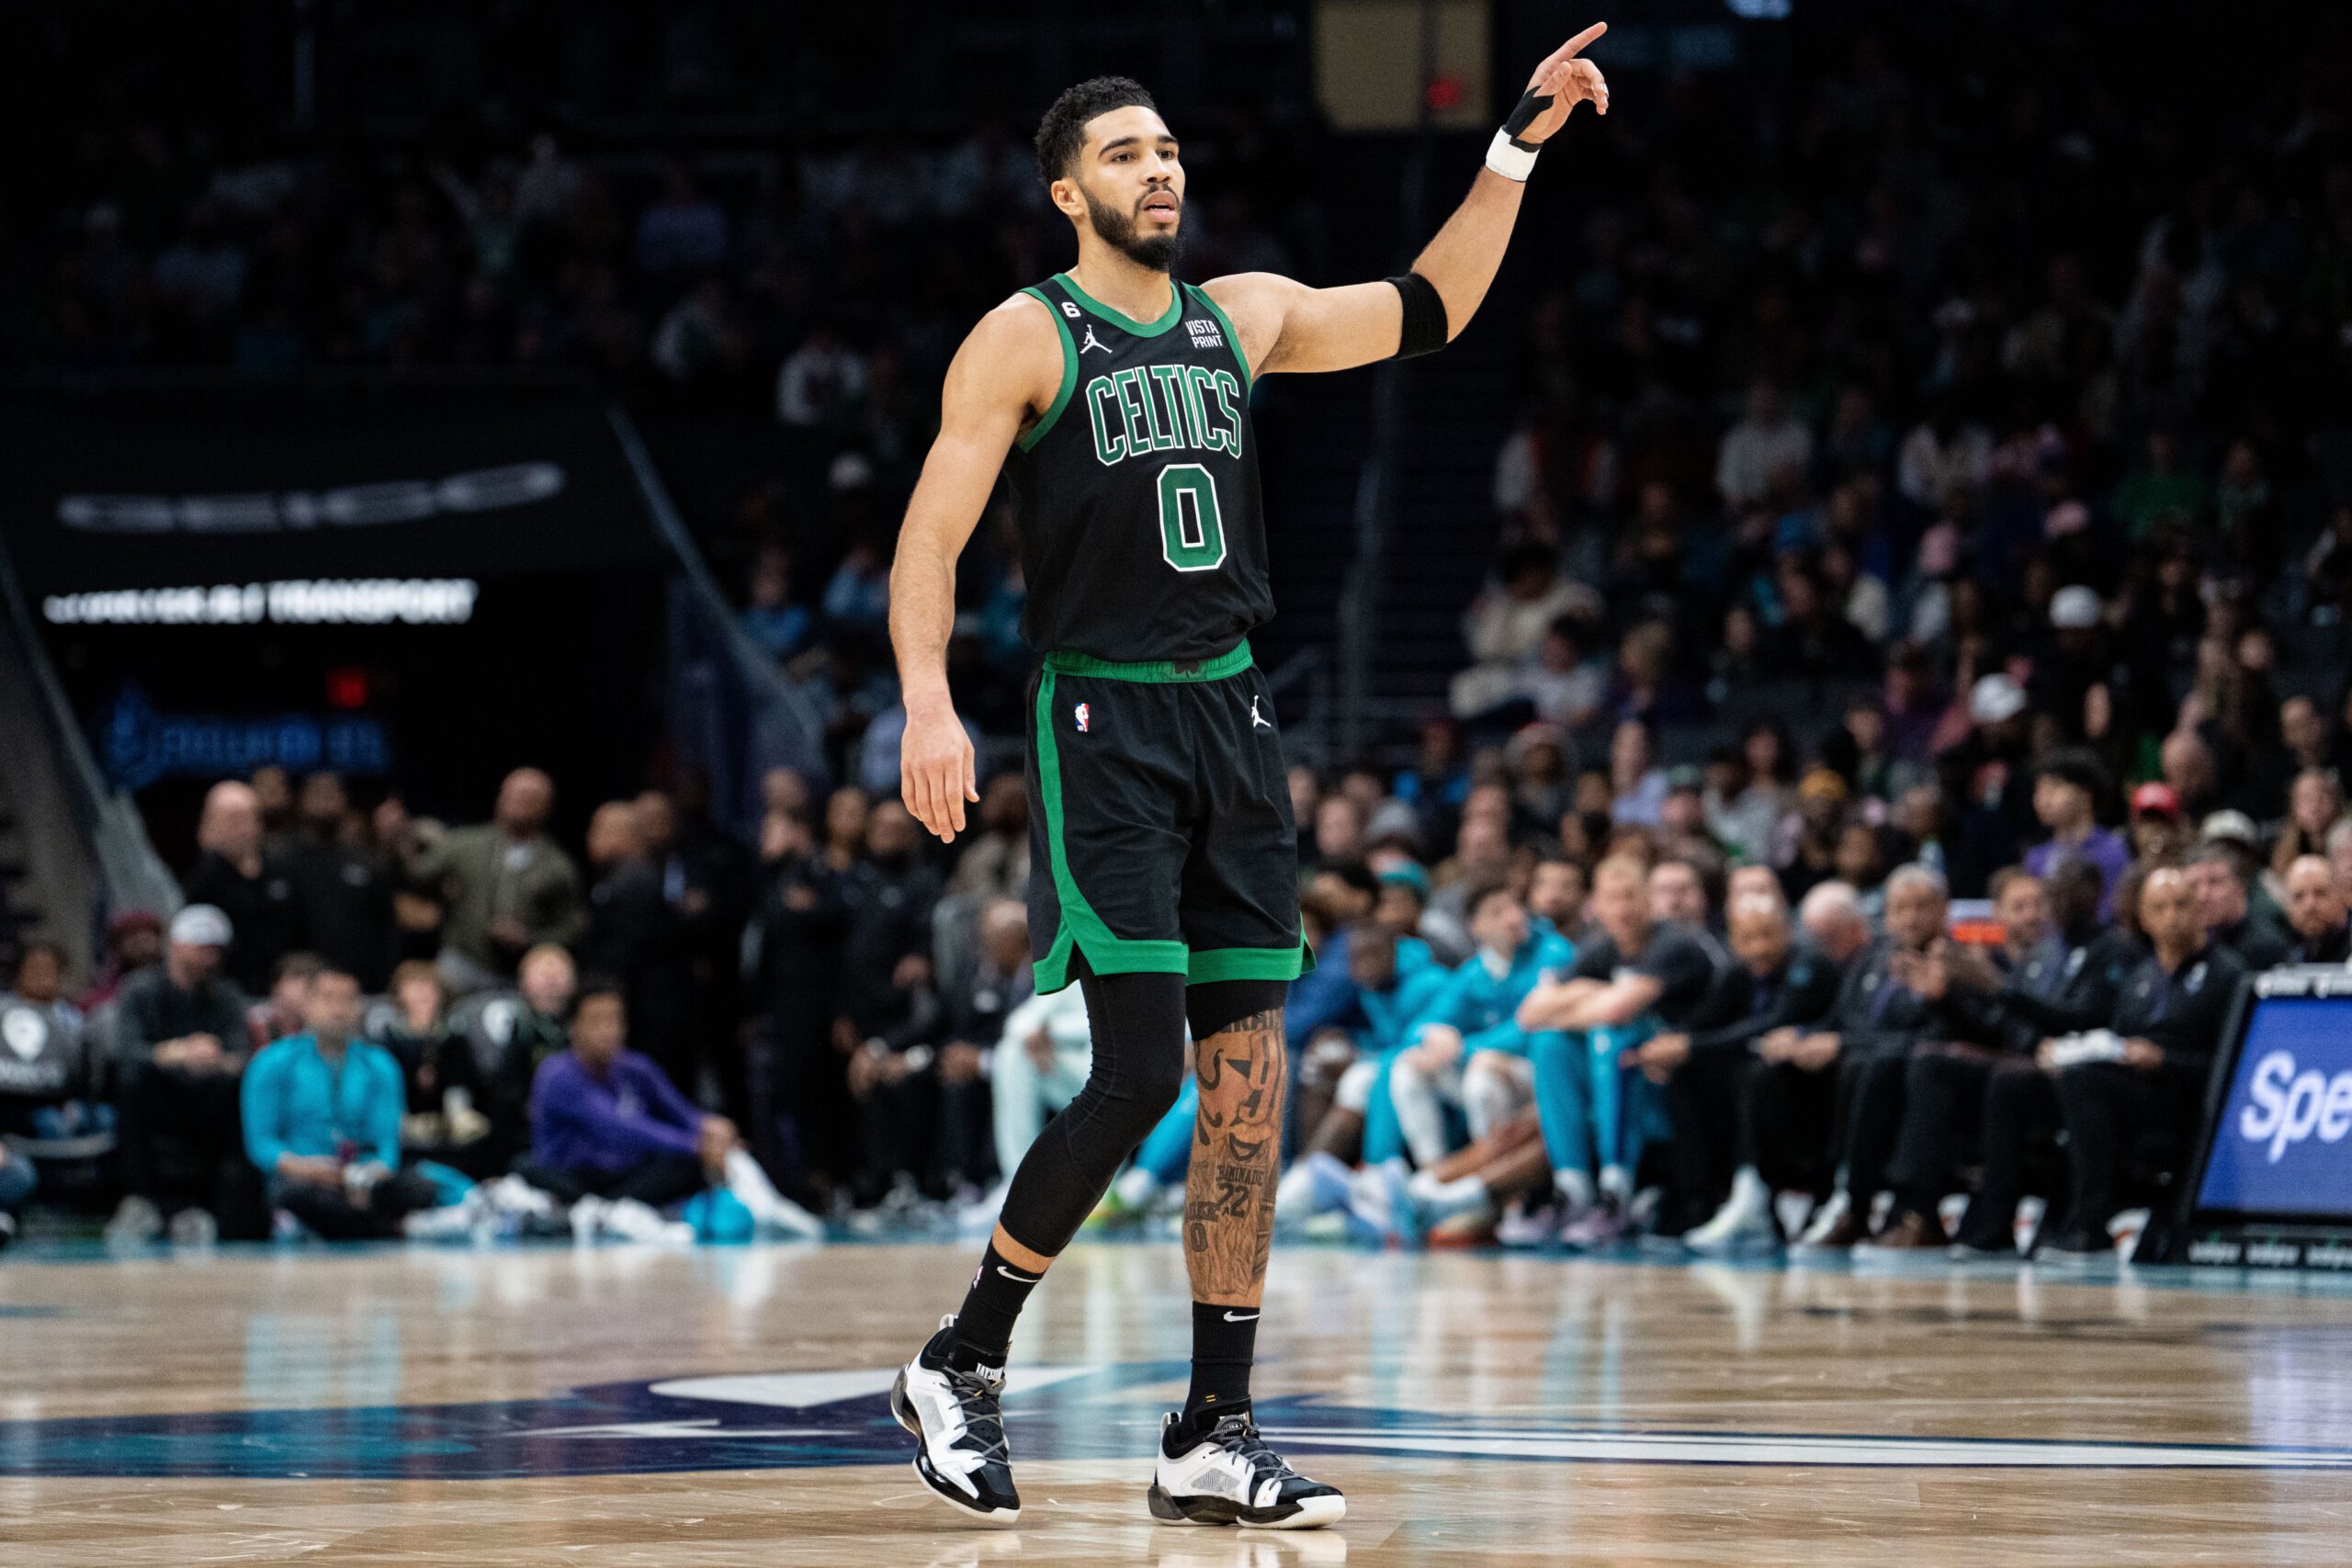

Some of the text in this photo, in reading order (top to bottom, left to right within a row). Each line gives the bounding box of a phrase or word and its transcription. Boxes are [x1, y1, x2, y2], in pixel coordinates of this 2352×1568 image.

[1061, 301, 1081, 318] 6
[1184, 320, 1220, 336] VISTA
[1191, 334, 1223, 348] PRINT
[1085, 364, 1241, 467] CELTICS
[1156, 463, 1227, 572] 0
